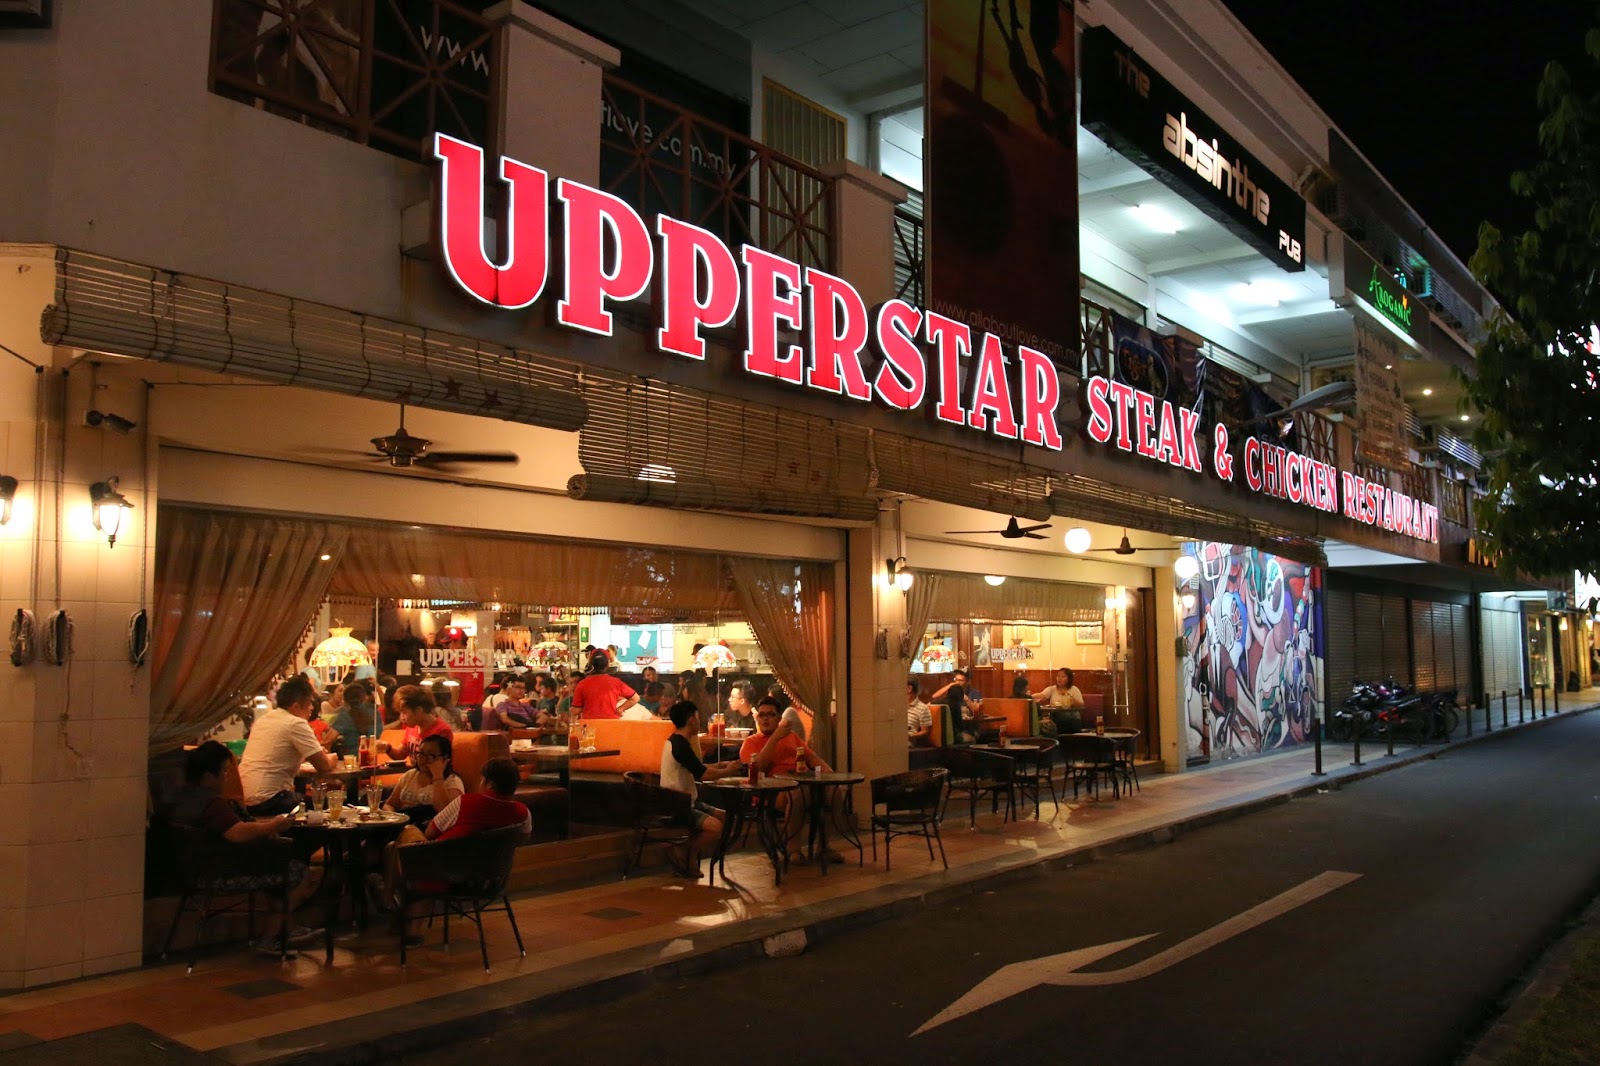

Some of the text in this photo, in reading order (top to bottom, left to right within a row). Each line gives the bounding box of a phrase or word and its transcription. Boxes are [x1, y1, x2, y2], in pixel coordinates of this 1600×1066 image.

[1163, 112, 1270, 225] absinthe
[1279, 229, 1301, 263] PUB
[434, 132, 1438, 544] UPPERSTAR STEAK & CHICKEN RESTAURANT
[934, 297, 1080, 366] www.allaboutlove.com.my
[419, 648, 516, 667] UPPERSTAR
